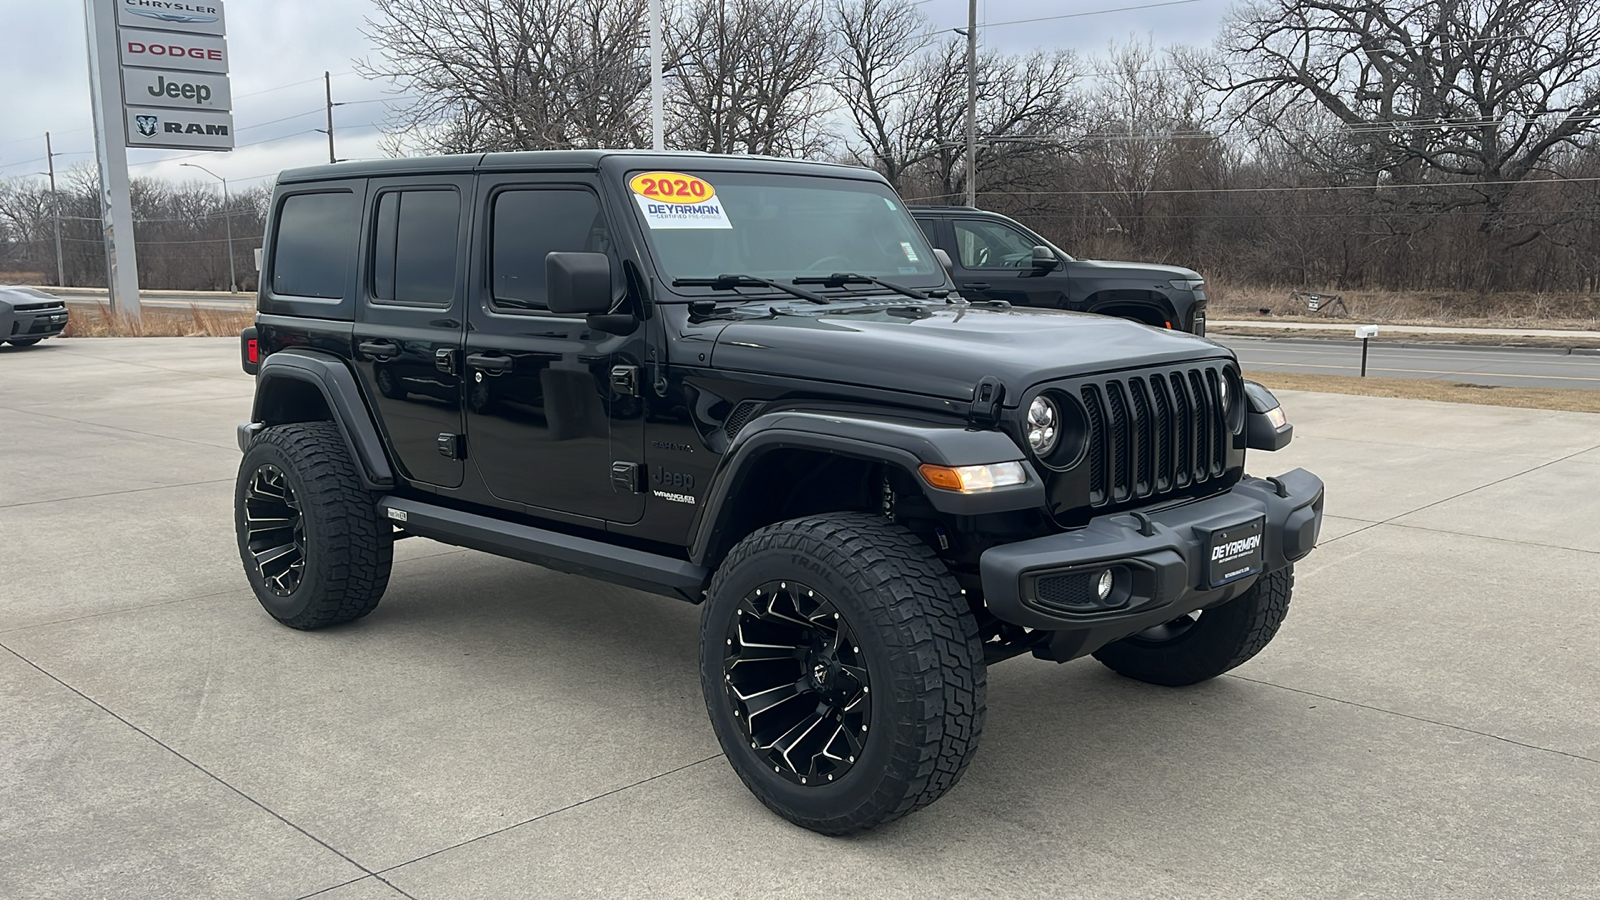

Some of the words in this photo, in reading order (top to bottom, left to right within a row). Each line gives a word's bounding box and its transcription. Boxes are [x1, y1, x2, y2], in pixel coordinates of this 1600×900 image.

[126, 0, 216, 14] CHRYSLER
[128, 42, 222, 61] DODGE
[147, 75, 211, 104] Jeep
[164, 122, 229, 136] RAM
[641, 178, 705, 197] 2020
[648, 204, 719, 215] DEYARMAN
[652, 466, 694, 491] Jeep
[653, 489, 695, 502] WRANGLER
[1211, 533, 1261, 560] DEYARMAN
[791, 554, 833, 585] TRAIL
